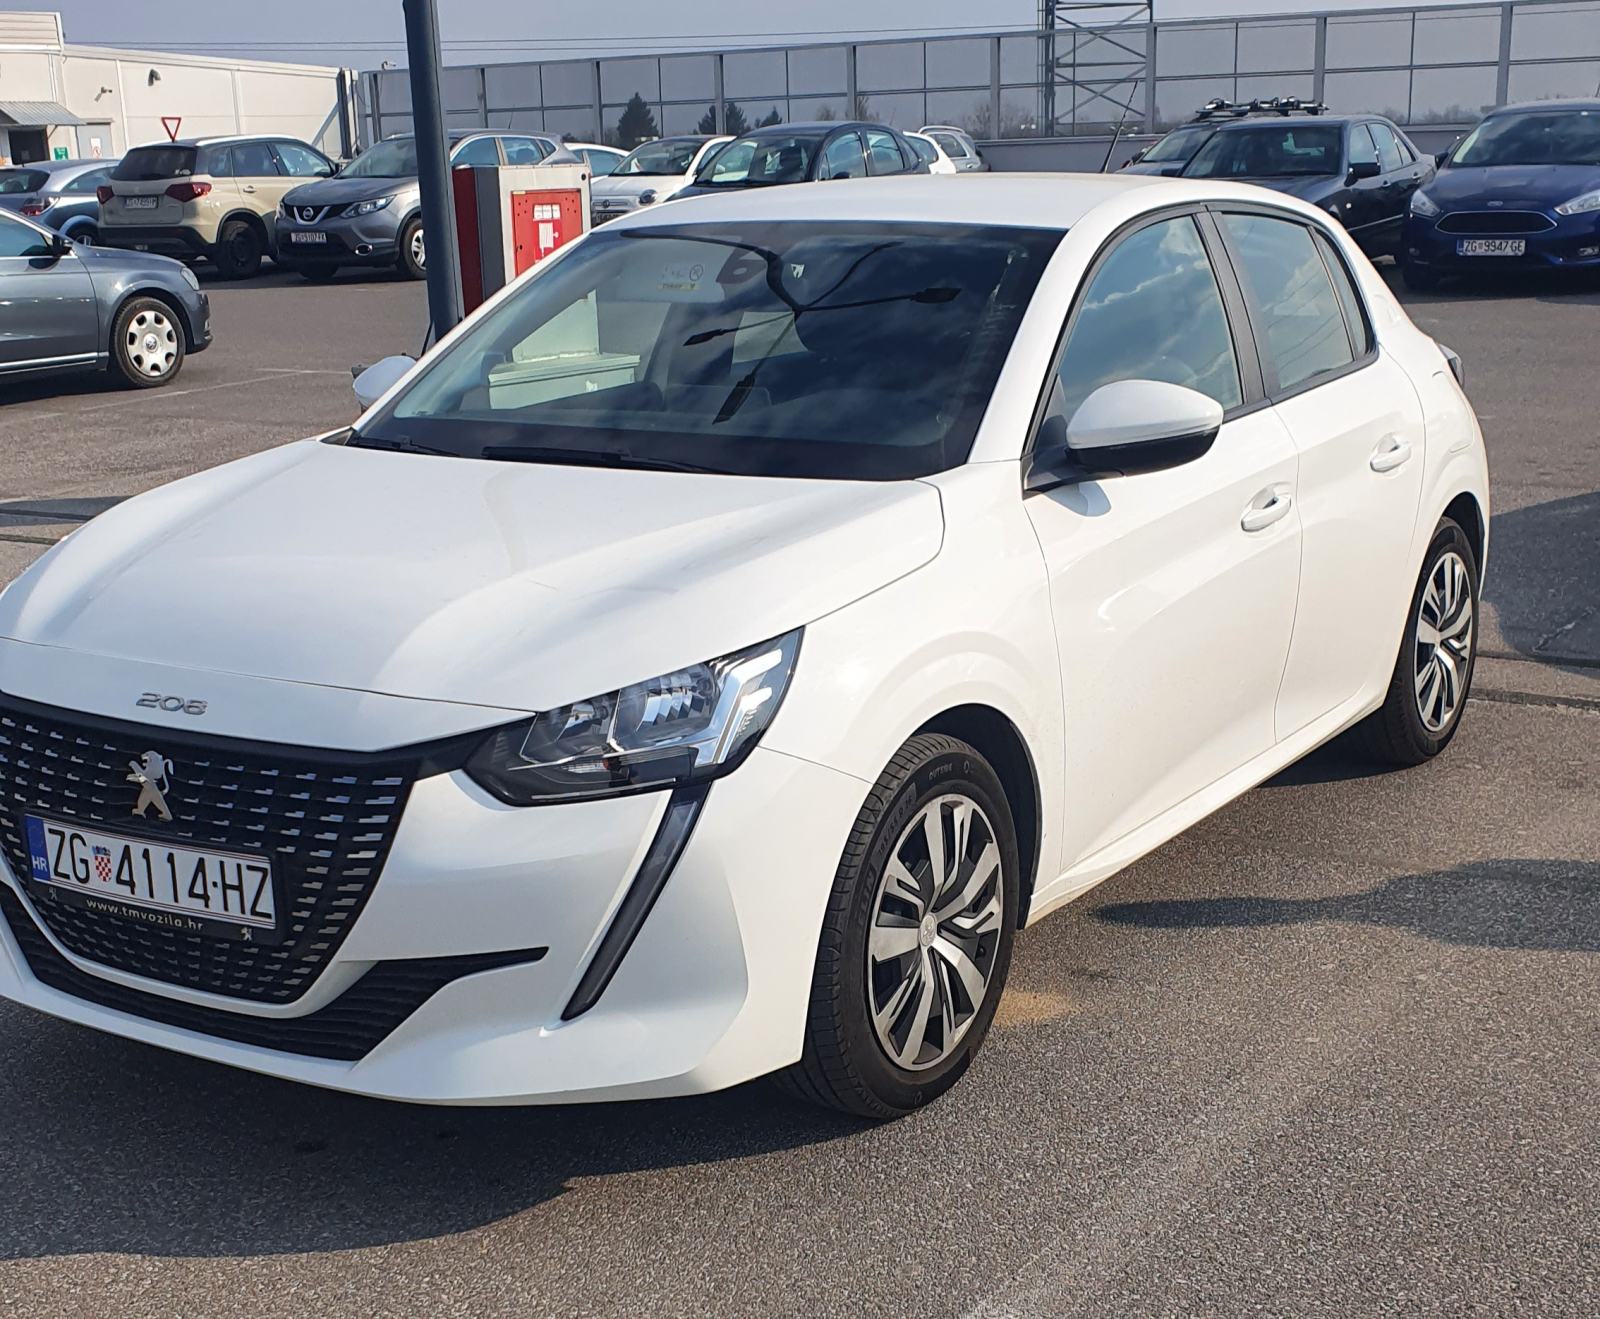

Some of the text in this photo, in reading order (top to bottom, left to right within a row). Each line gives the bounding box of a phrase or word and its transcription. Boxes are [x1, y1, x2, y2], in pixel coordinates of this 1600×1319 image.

[32, 855, 48, 872] HR
[48, 828, 90, 884] ZG
[86, 899, 203, 931] www.tmvozila.hr
